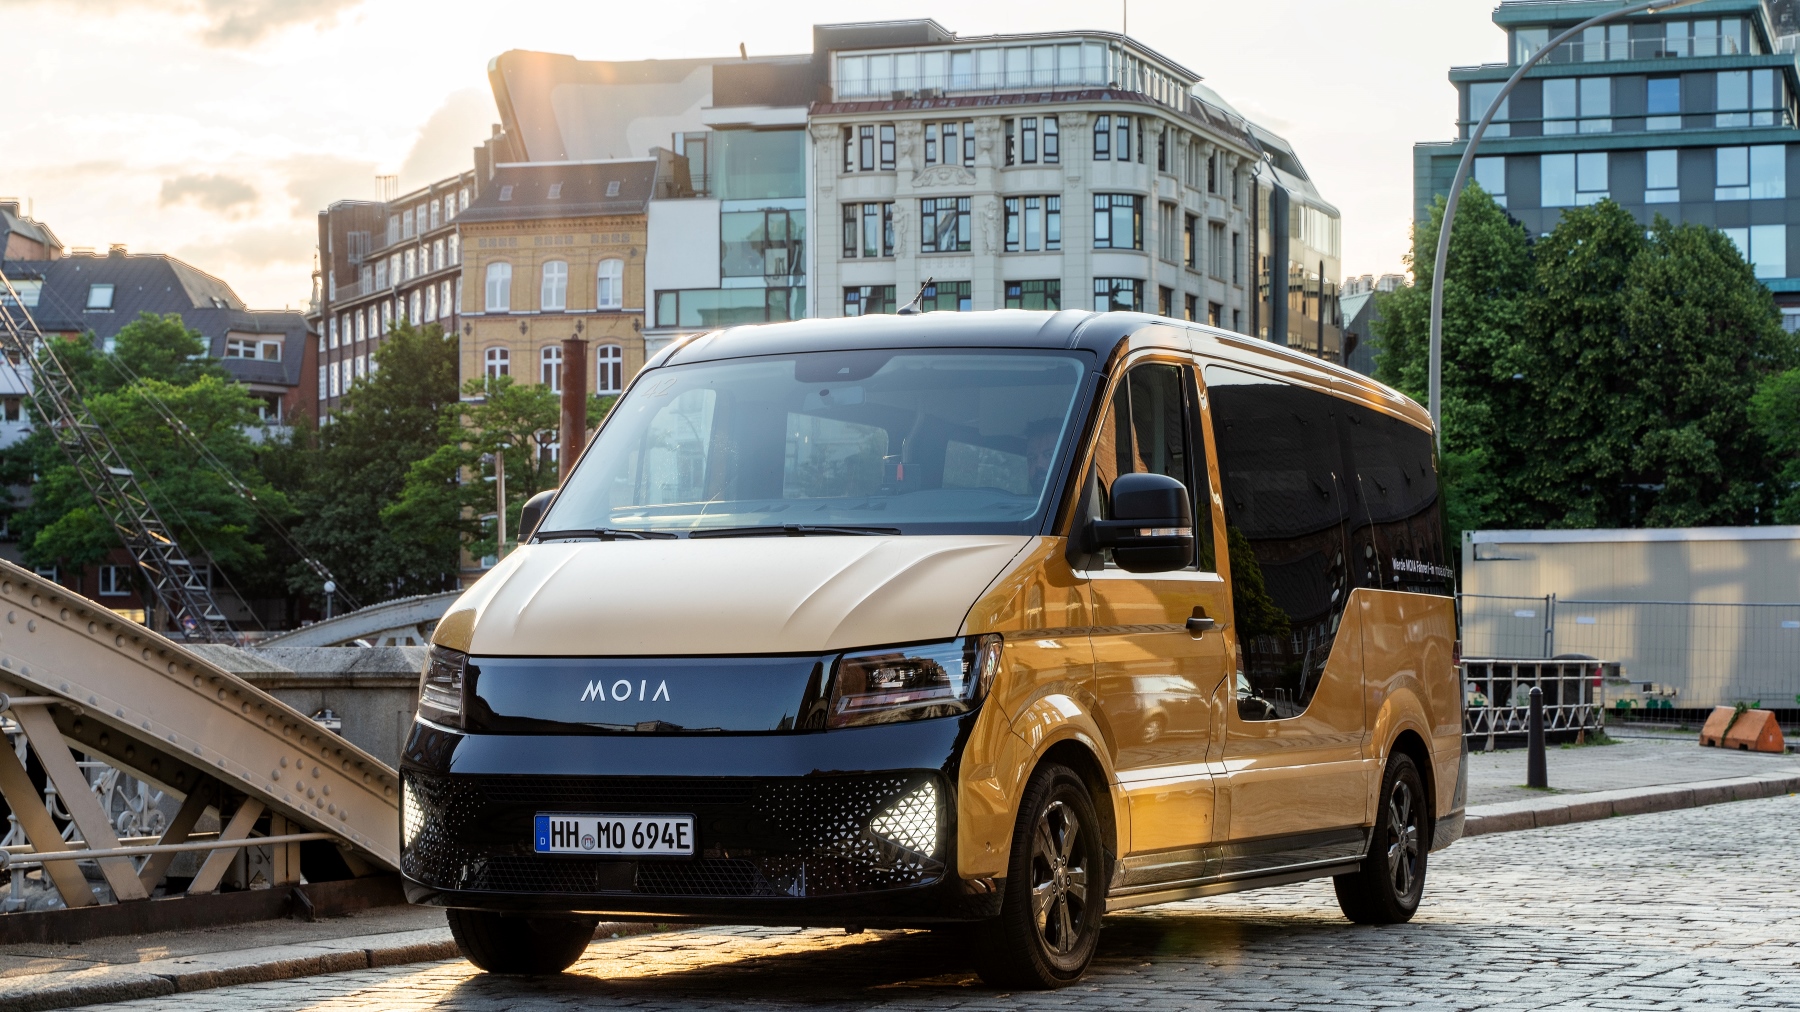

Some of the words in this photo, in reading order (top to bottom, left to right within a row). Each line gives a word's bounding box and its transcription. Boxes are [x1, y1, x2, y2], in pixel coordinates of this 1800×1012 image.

[1405, 559, 1416, 572] MOIA
[580, 679, 671, 702] MOIA
[540, 837, 546, 845] D
[551, 821, 579, 848] HH
[597, 821, 626, 849] MO
[631, 822, 690, 850] 694E
